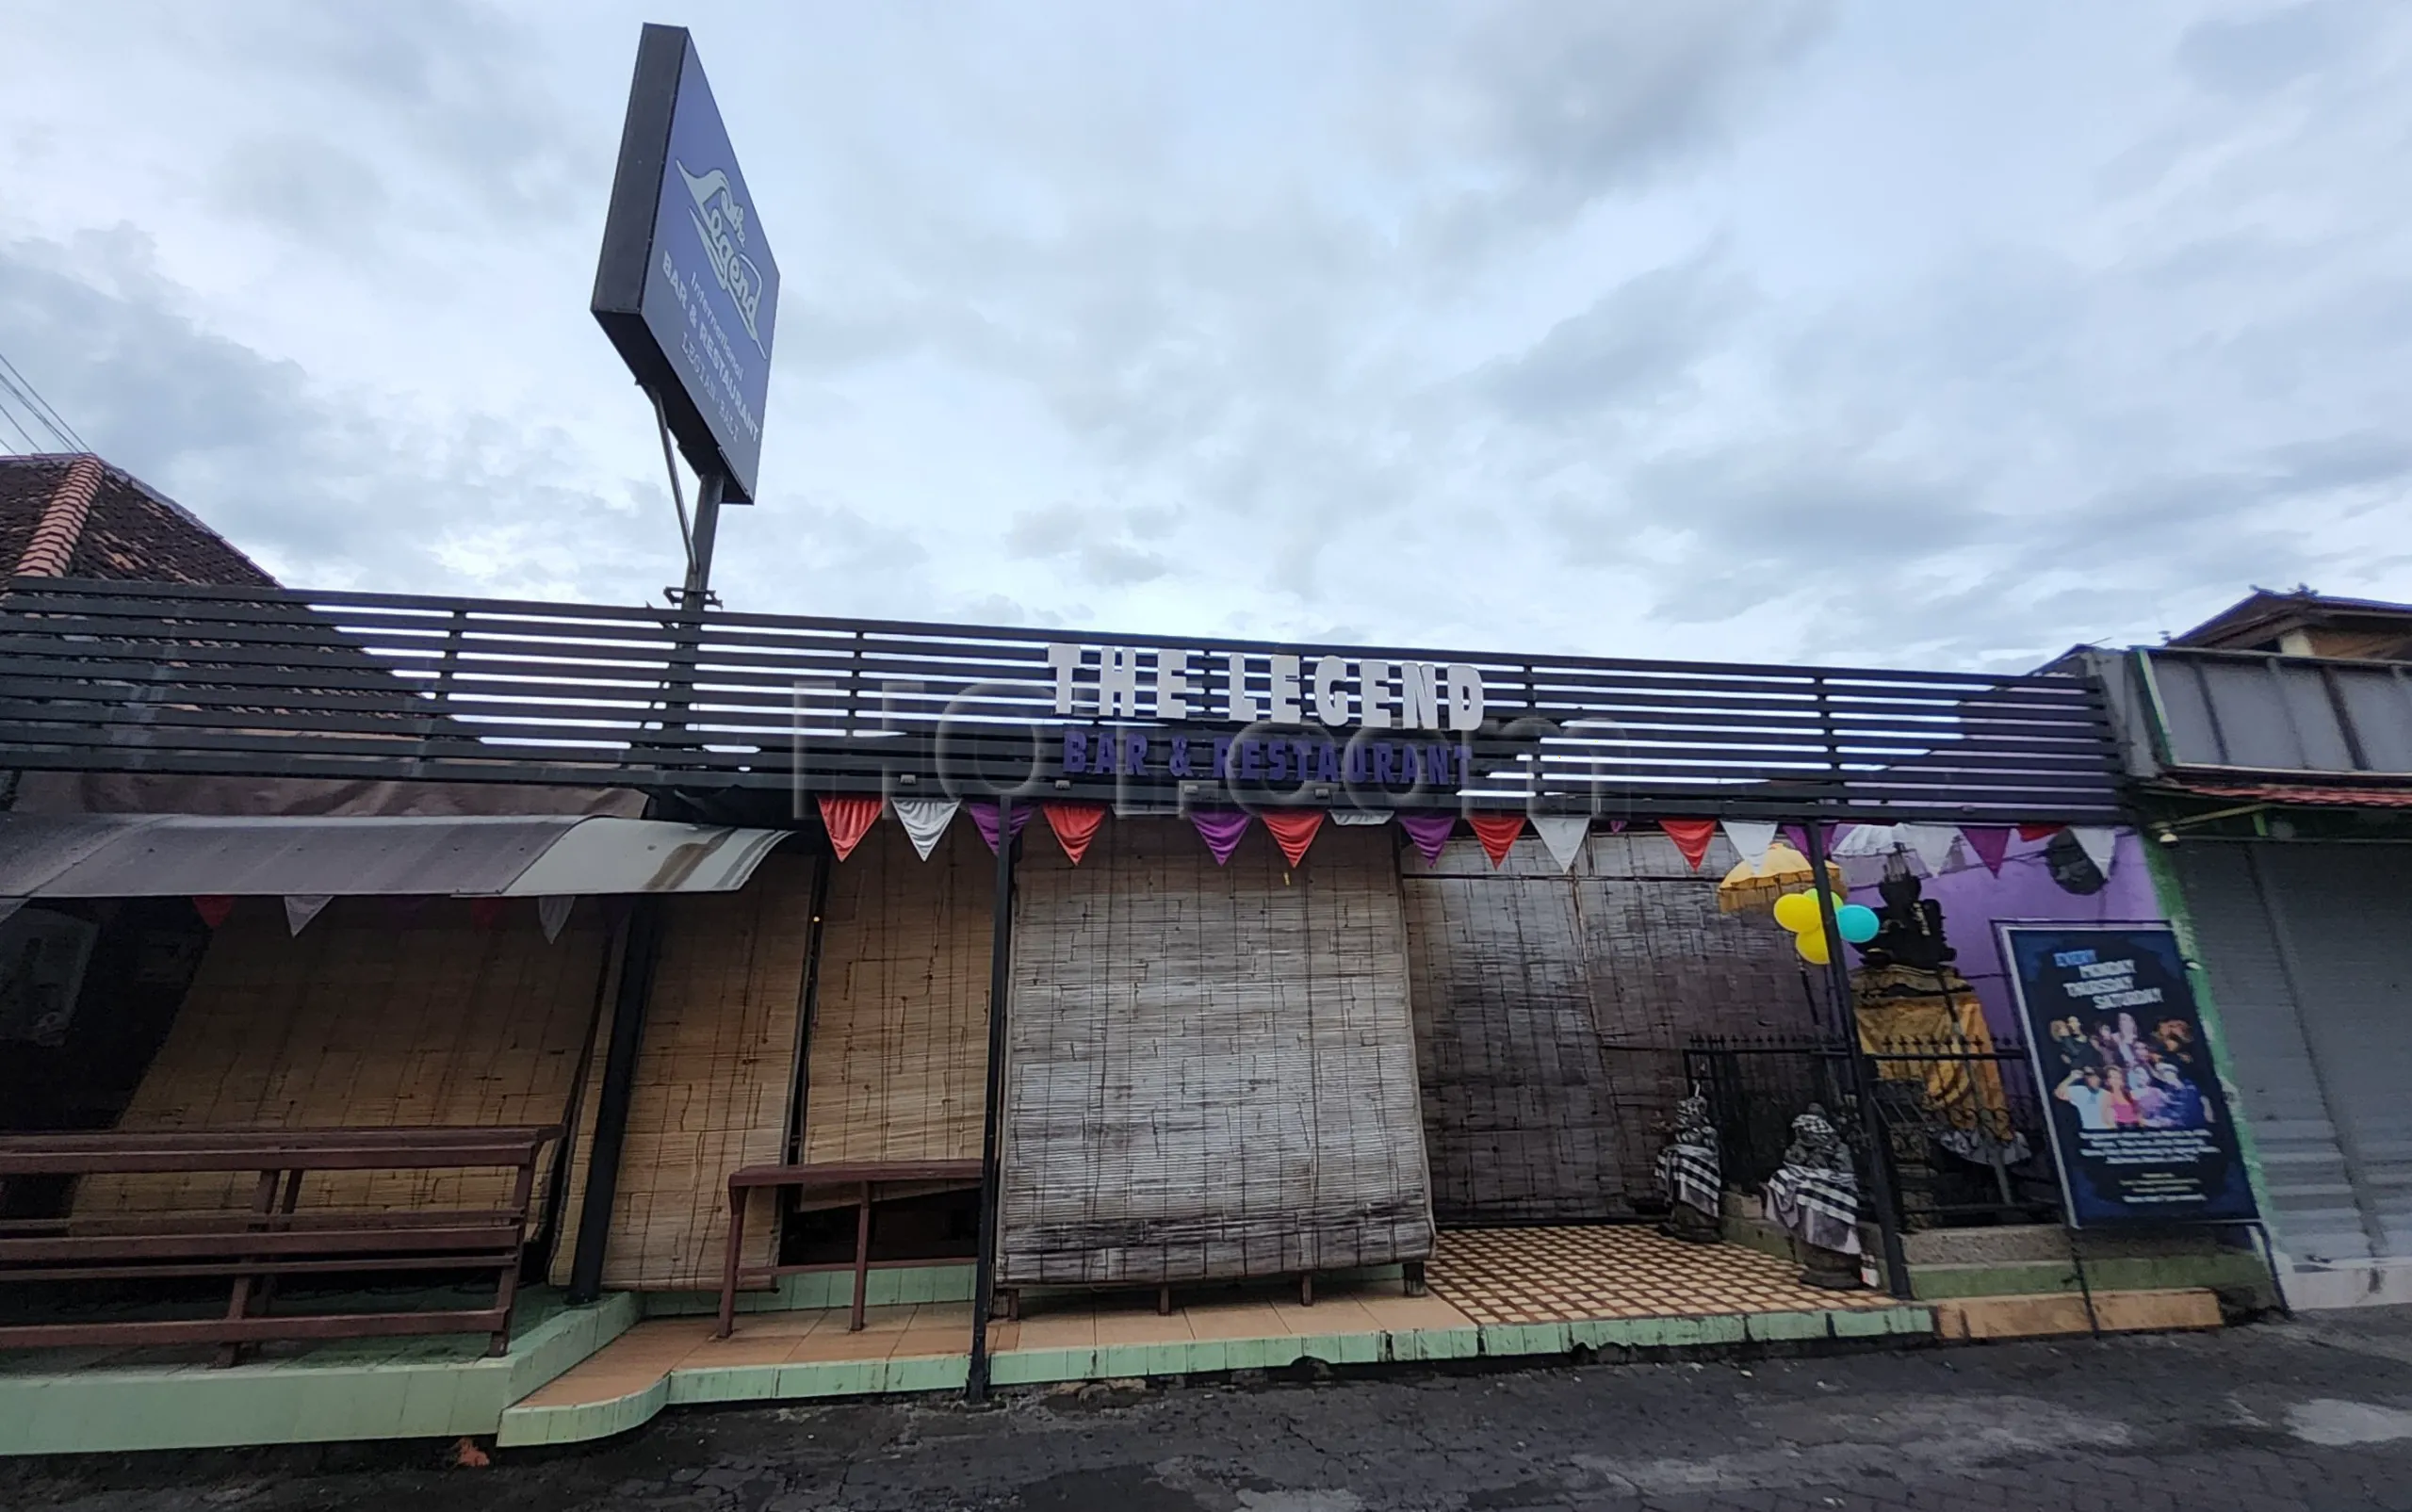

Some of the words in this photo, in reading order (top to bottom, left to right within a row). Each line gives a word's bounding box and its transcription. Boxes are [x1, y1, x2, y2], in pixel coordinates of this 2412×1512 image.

[661, 249, 688, 313] BAR
[688, 301, 699, 331] &
[698, 324, 759, 445] RESTAURANT
[691, 268, 743, 383] International
[1049, 643, 1188, 719] THE
[1229, 654, 1485, 731] LEGEND
[1062, 730, 1149, 778] BAR
[1168, 734, 1194, 778] &
[1212, 735, 1474, 786] RESTAURANT
